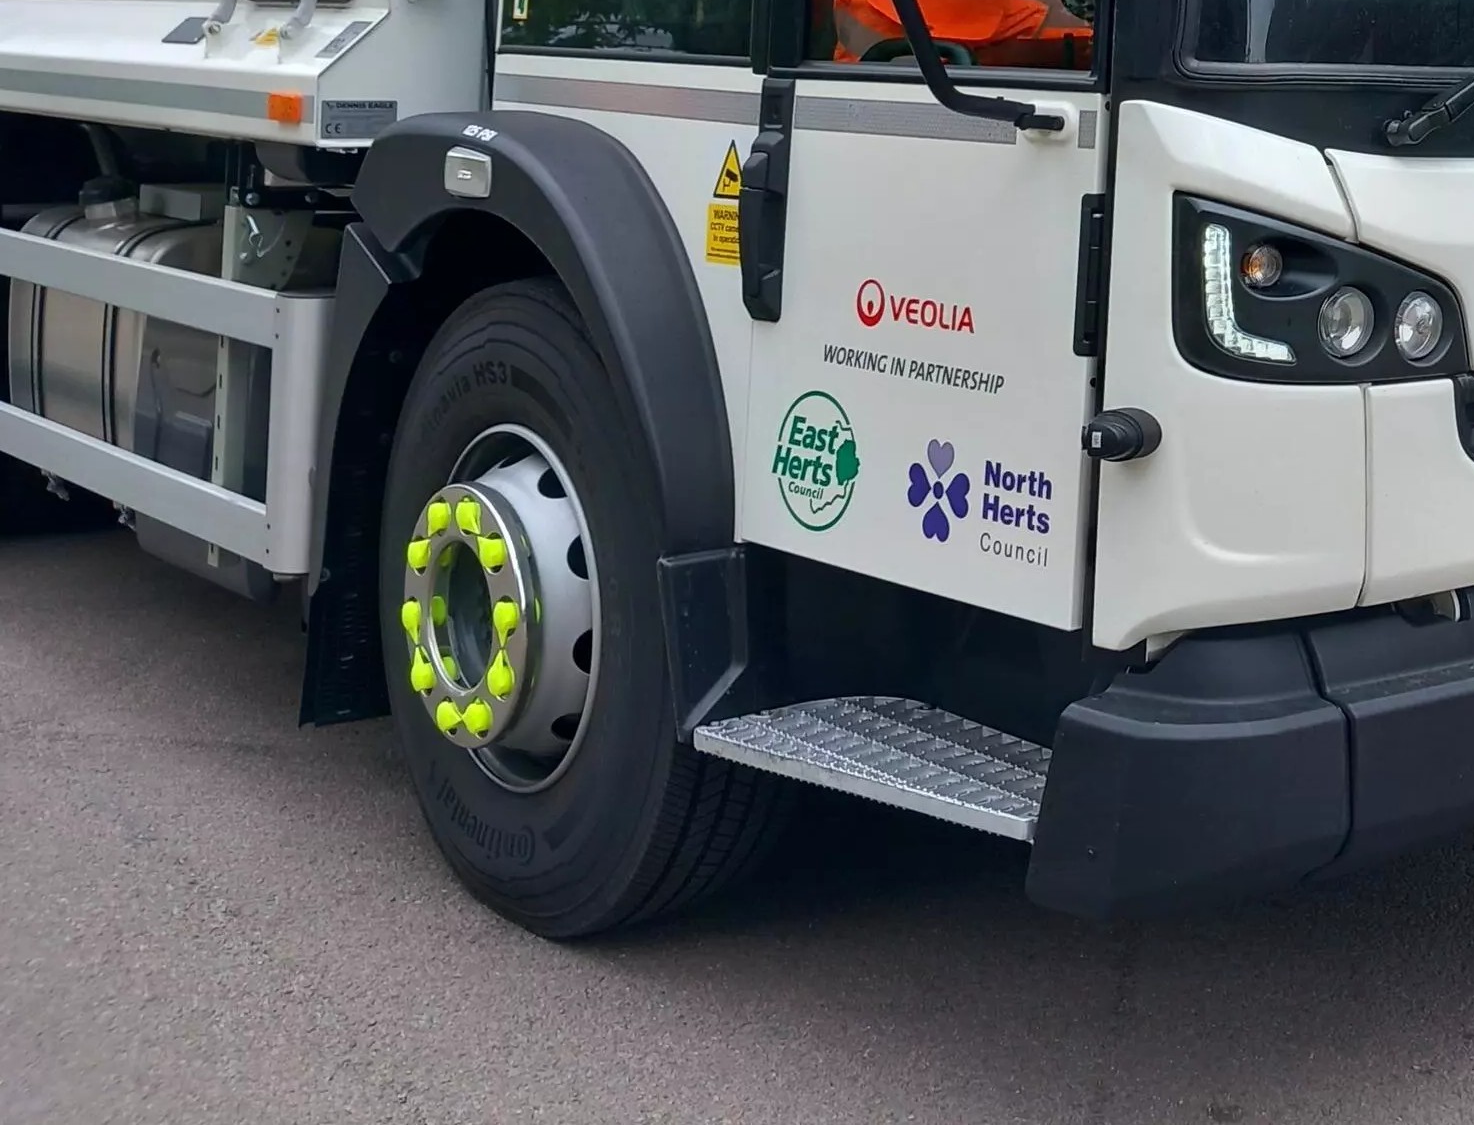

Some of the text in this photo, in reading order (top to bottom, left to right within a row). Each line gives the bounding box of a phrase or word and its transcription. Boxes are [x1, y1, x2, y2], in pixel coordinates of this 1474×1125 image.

[336, 101, 366, 109] DENNIS
[889, 295, 975, 334] VEOLIA
[472, 360, 508, 388] HS3
[823, 343, 1006, 395] WORKING IN PARTNERSHIP
[788, 415, 840, 455] East
[771, 444, 833, 488] Herts
[984, 459, 1053, 501] North
[788, 480, 824, 500] Council
[981, 492, 1051, 536] Herts
[979, 531, 1050, 568] Council
